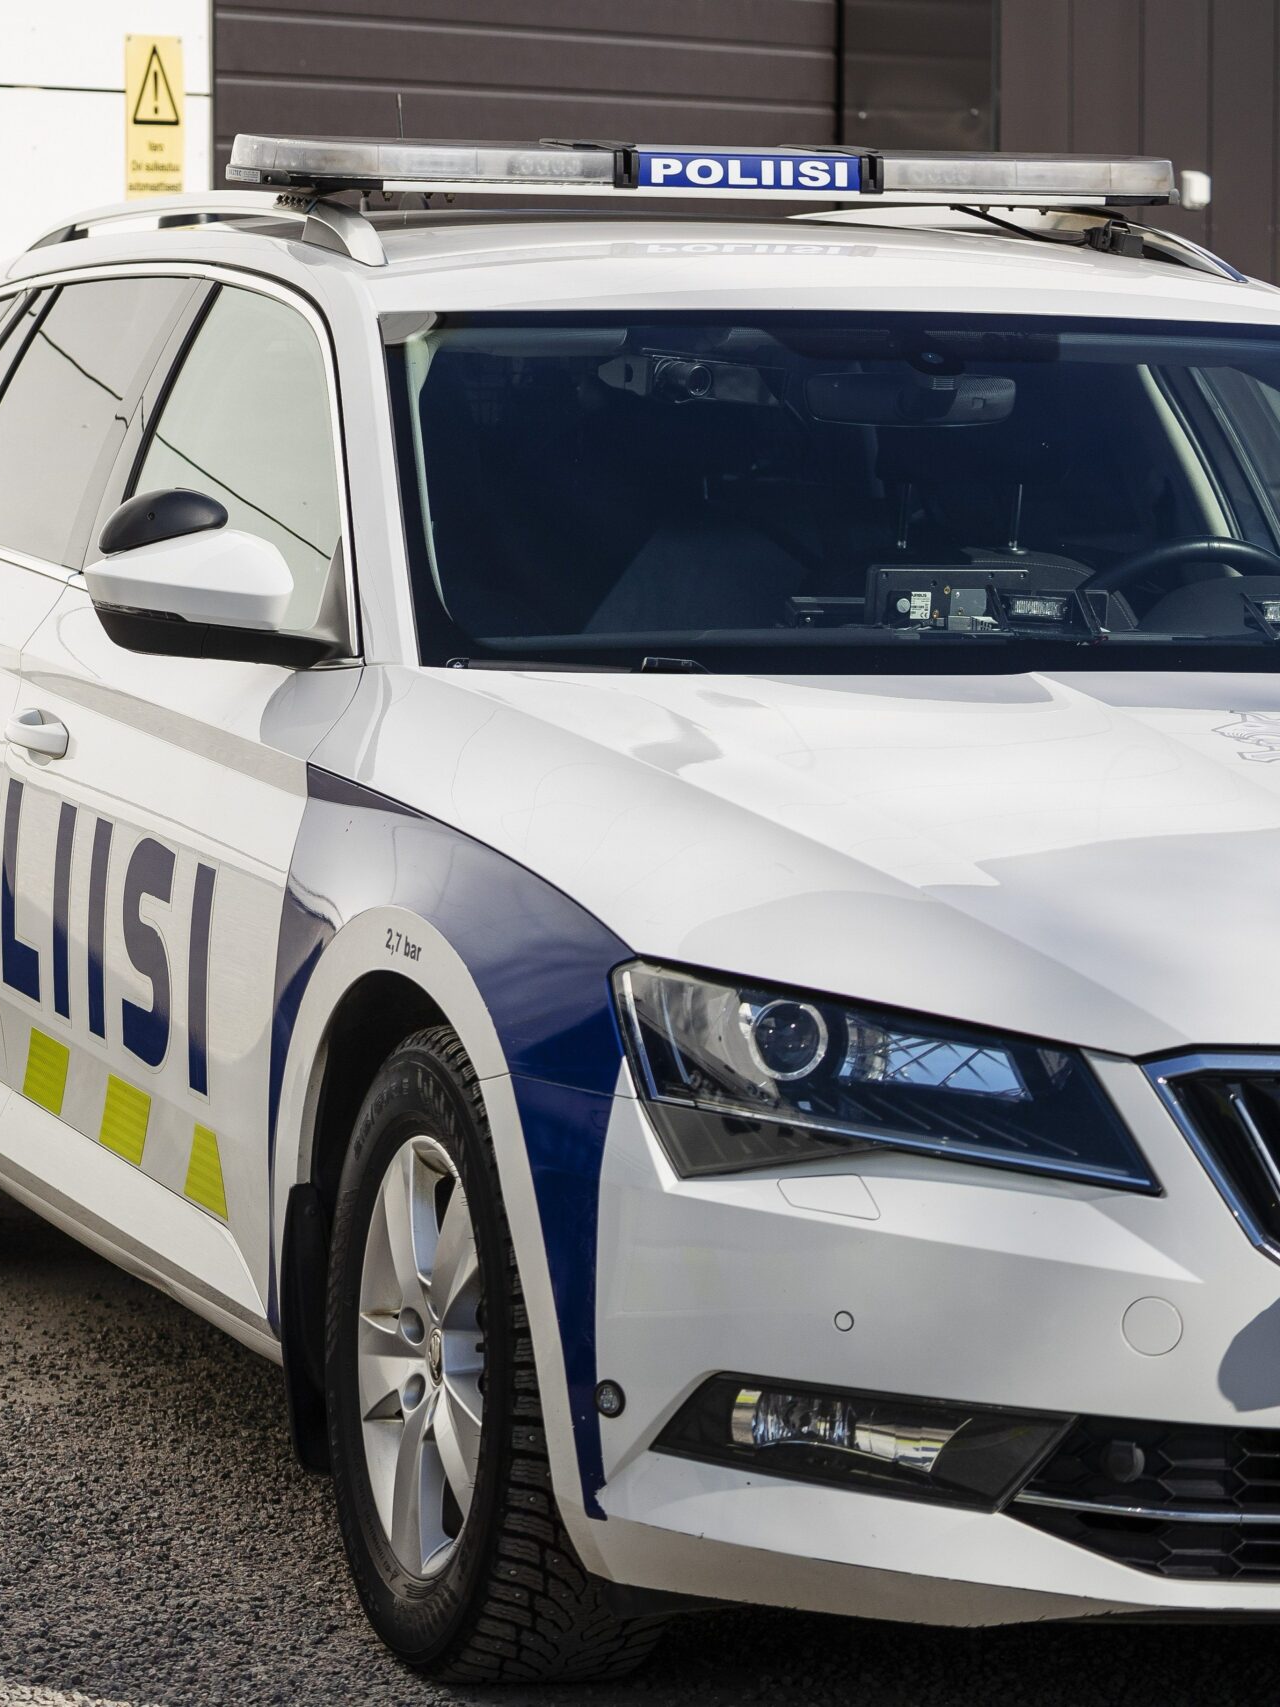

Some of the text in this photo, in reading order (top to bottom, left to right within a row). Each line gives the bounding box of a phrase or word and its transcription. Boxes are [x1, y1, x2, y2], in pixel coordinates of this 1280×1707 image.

[651, 158, 848, 187] POLIISI
[385, 927, 422, 962] 2,7 bar
